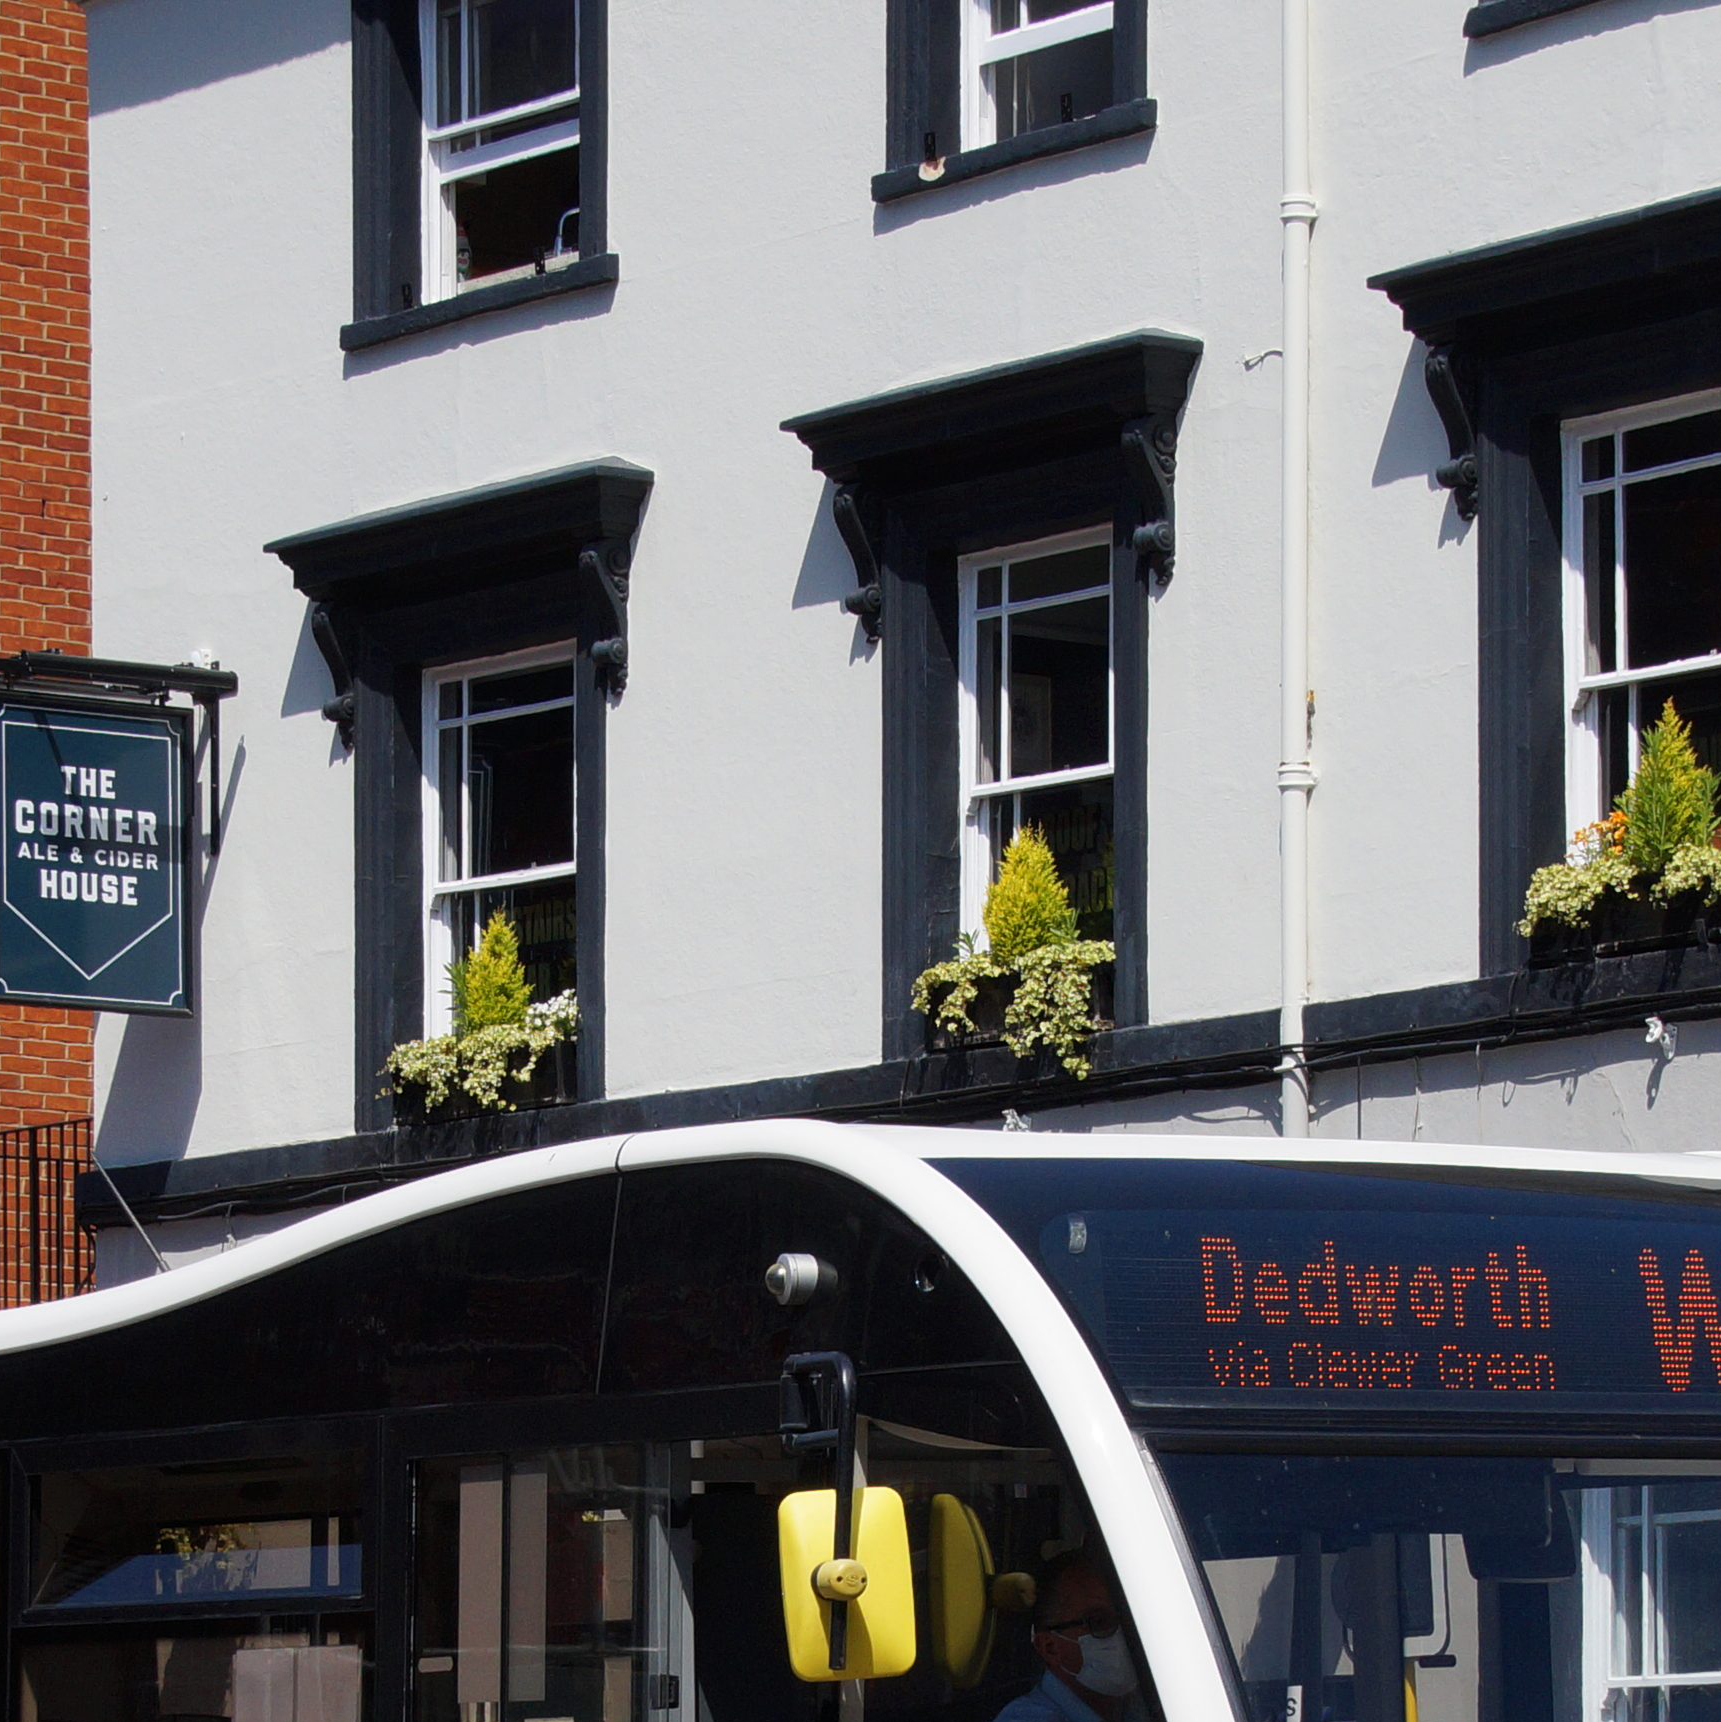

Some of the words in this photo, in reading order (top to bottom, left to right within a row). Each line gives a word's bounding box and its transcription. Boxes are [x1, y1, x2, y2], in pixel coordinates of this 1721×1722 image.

[60, 765, 116, 799] THE
[15, 799, 160, 847] CORNER
[18, 841, 59, 862] ALE
[69, 846, 84, 864] &
[94, 848, 159, 871] CIDER
[40, 868, 139, 906] HOUSE
[1200, 1236, 1551, 1330] Dedworth
[1207, 1340, 1271, 1387] via
[1288, 1342, 1420, 1388] Clewer
[1438, 1344, 1556, 1390] Green
